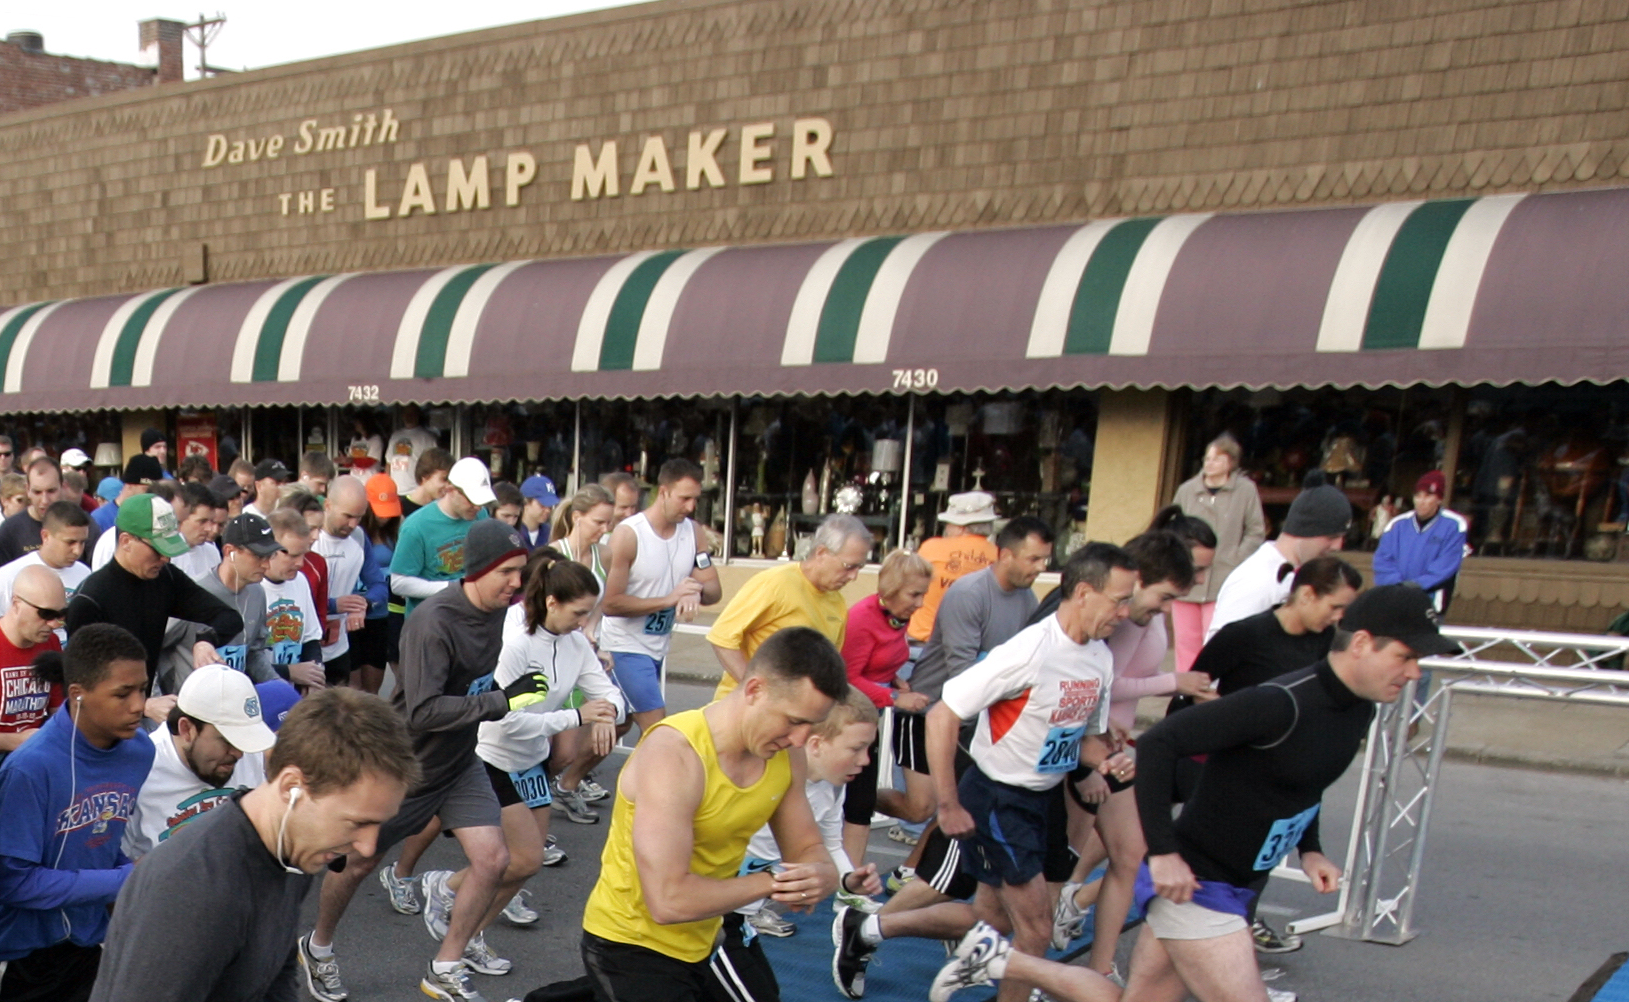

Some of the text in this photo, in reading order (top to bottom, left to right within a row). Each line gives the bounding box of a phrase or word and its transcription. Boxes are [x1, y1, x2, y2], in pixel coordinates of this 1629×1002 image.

[202, 109, 400, 168] Dave Smith
[278, 117, 834, 220] THE LAMP MAKER
[892, 369, 939, 389] 7430
[347, 384, 379, 401] 7432
[1059, 678, 1100, 691] RUNNING
